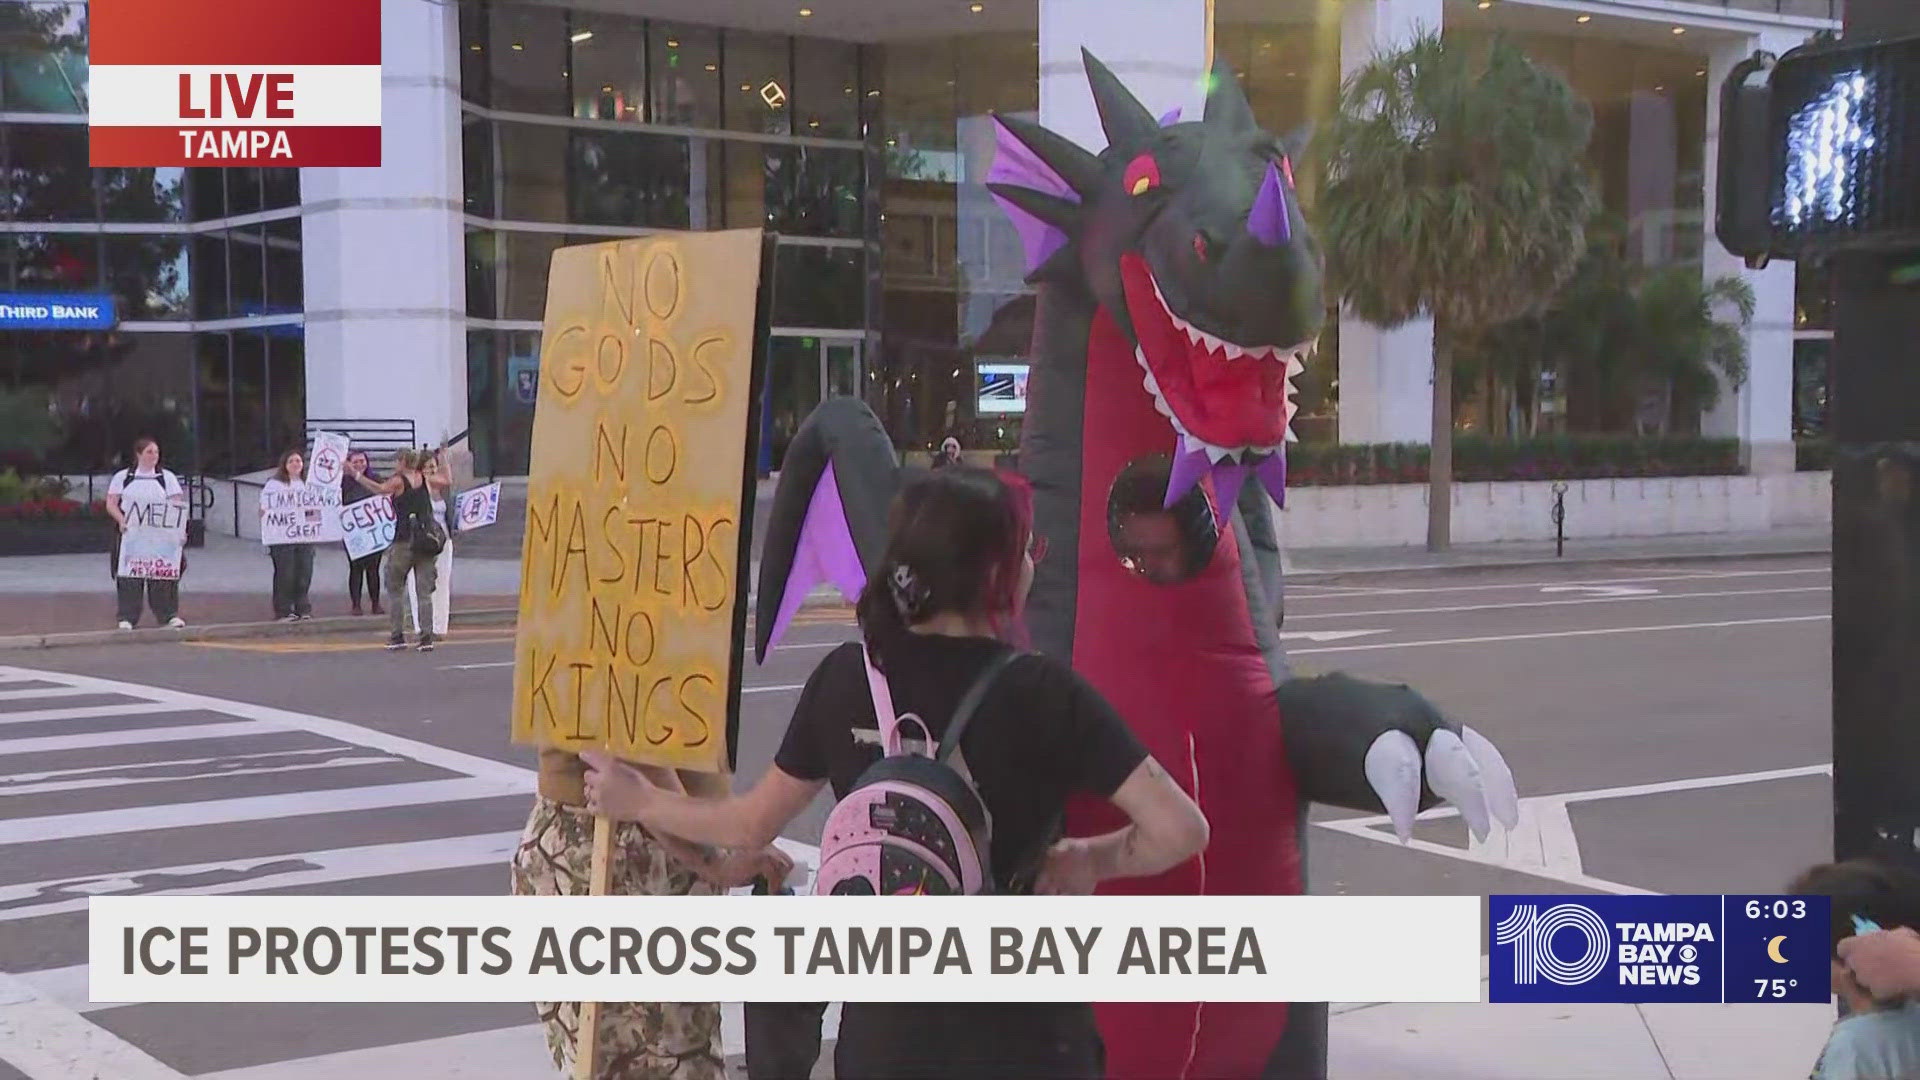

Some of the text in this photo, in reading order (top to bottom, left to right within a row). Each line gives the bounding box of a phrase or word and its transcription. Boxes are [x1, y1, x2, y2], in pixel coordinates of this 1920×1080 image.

[51, 305, 99, 319] BANK
[603, 250, 680, 326] NO
[550, 325, 726, 404] GODS
[596, 423, 677, 485] NO
[124, 501, 188, 529] MELT
[285, 521, 322, 538] GREAT
[366, 522, 396, 550] IC
[524, 493, 733, 611] MASTERS
[589, 597, 655, 667] NO
[529, 648, 714, 747] KINGS
